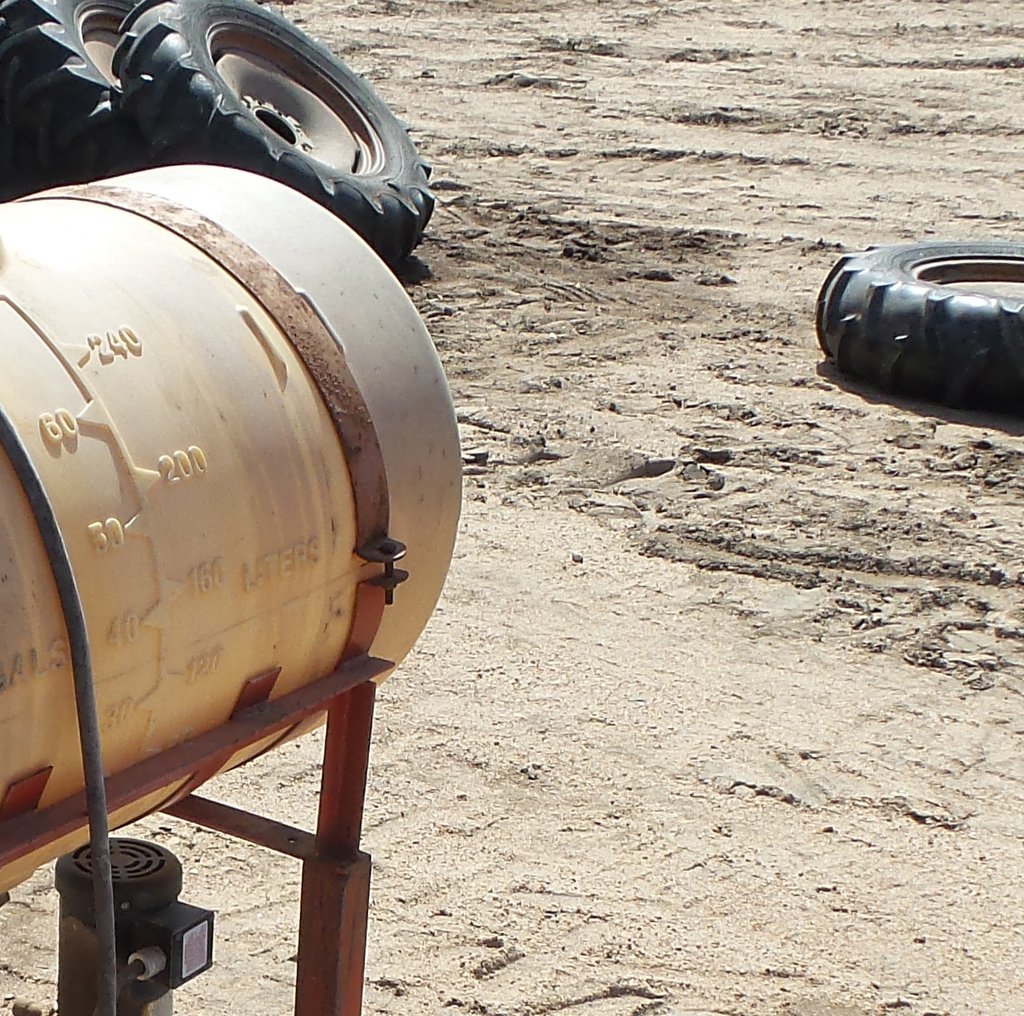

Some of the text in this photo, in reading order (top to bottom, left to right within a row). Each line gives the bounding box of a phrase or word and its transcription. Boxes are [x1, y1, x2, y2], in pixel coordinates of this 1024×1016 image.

[86, 325, 144, 367] 240
[38, 407, 78, 443] 60
[158, 445, 207, 484] 200
[87, 517, 125, 553] 50
